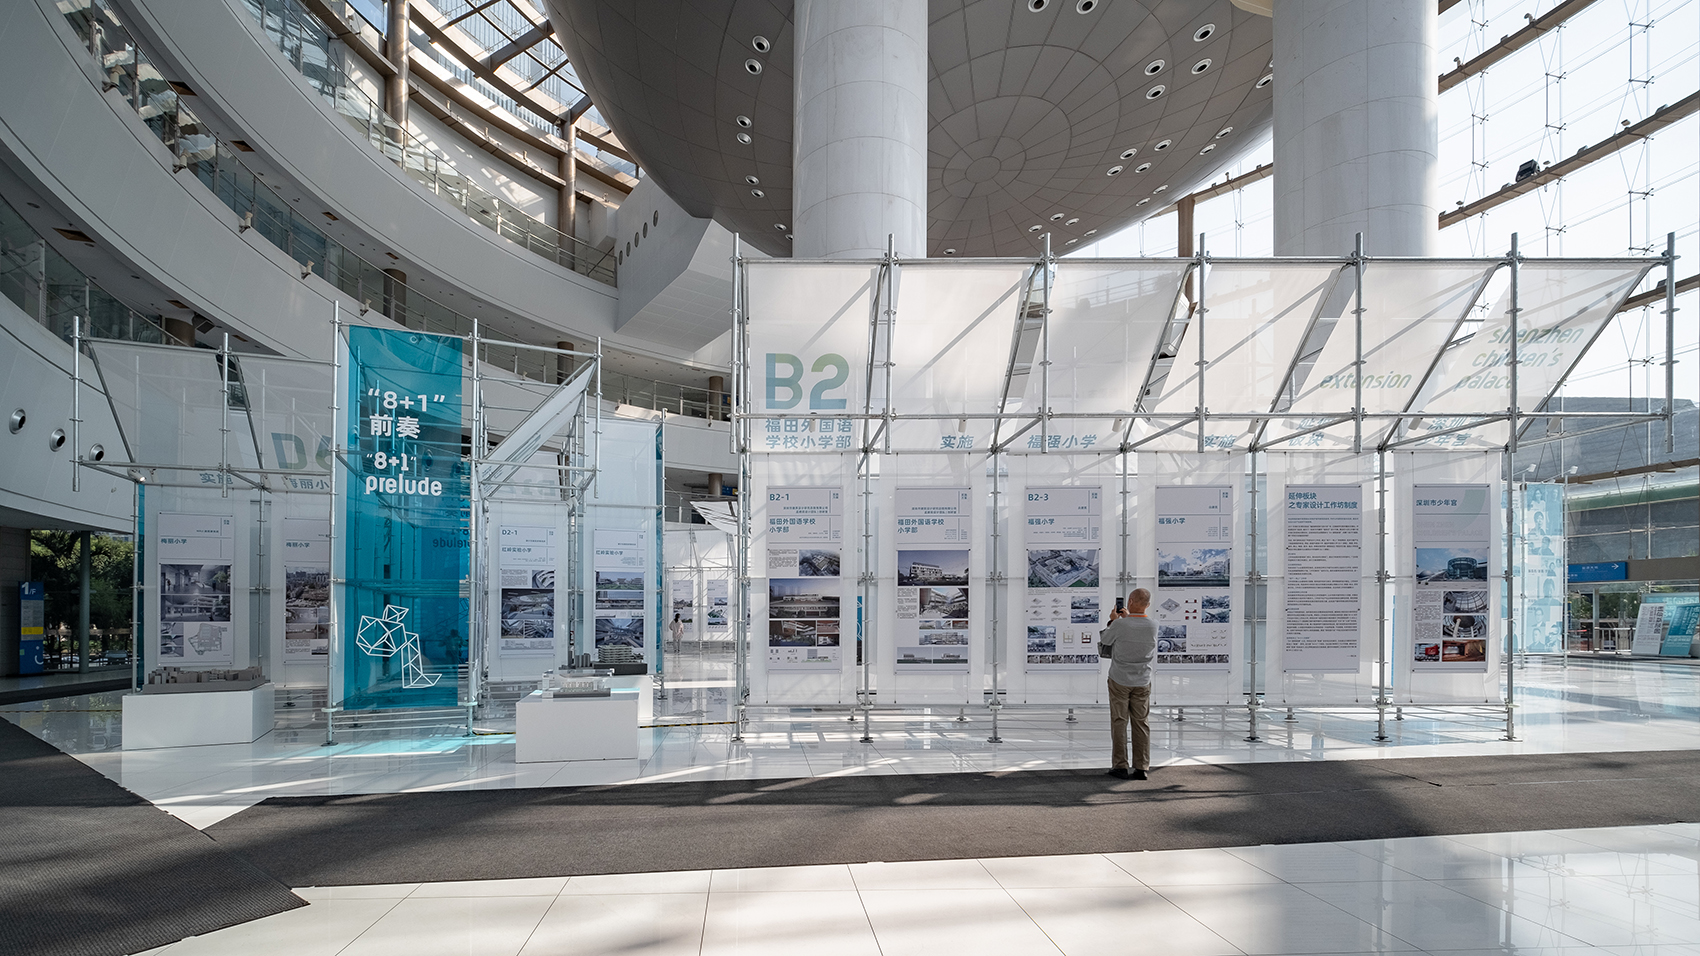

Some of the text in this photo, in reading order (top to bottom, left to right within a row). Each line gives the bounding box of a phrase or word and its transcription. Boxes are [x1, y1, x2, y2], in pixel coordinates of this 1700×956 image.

[1472, 347, 1564, 368] chiren's
[765, 352, 850, 410] B2
[1319, 371, 1413, 389] extension
[369, 414, 421, 439] 前奏
[765, 418, 854, 434] 福田外国语
[765, 434, 852, 450] 学校小学部
[940, 434, 975, 450] 实施
[1027, 434, 1097, 450] 福强小学
[1203, 434, 1237, 448] 实施
[199, 472, 234, 485] 实施
[365, 474, 442, 497] prelude
[769, 493, 790, 501] B2-1
[1027, 493, 1049, 501] B2-3
[1288, 492, 1317, 500] 延伸板块
[1288, 501, 1358, 509] 之专家设计工作坊制度
[897, 518, 945, 526] 福田外国语学校
[1158, 517, 1186, 525] 福强小学
